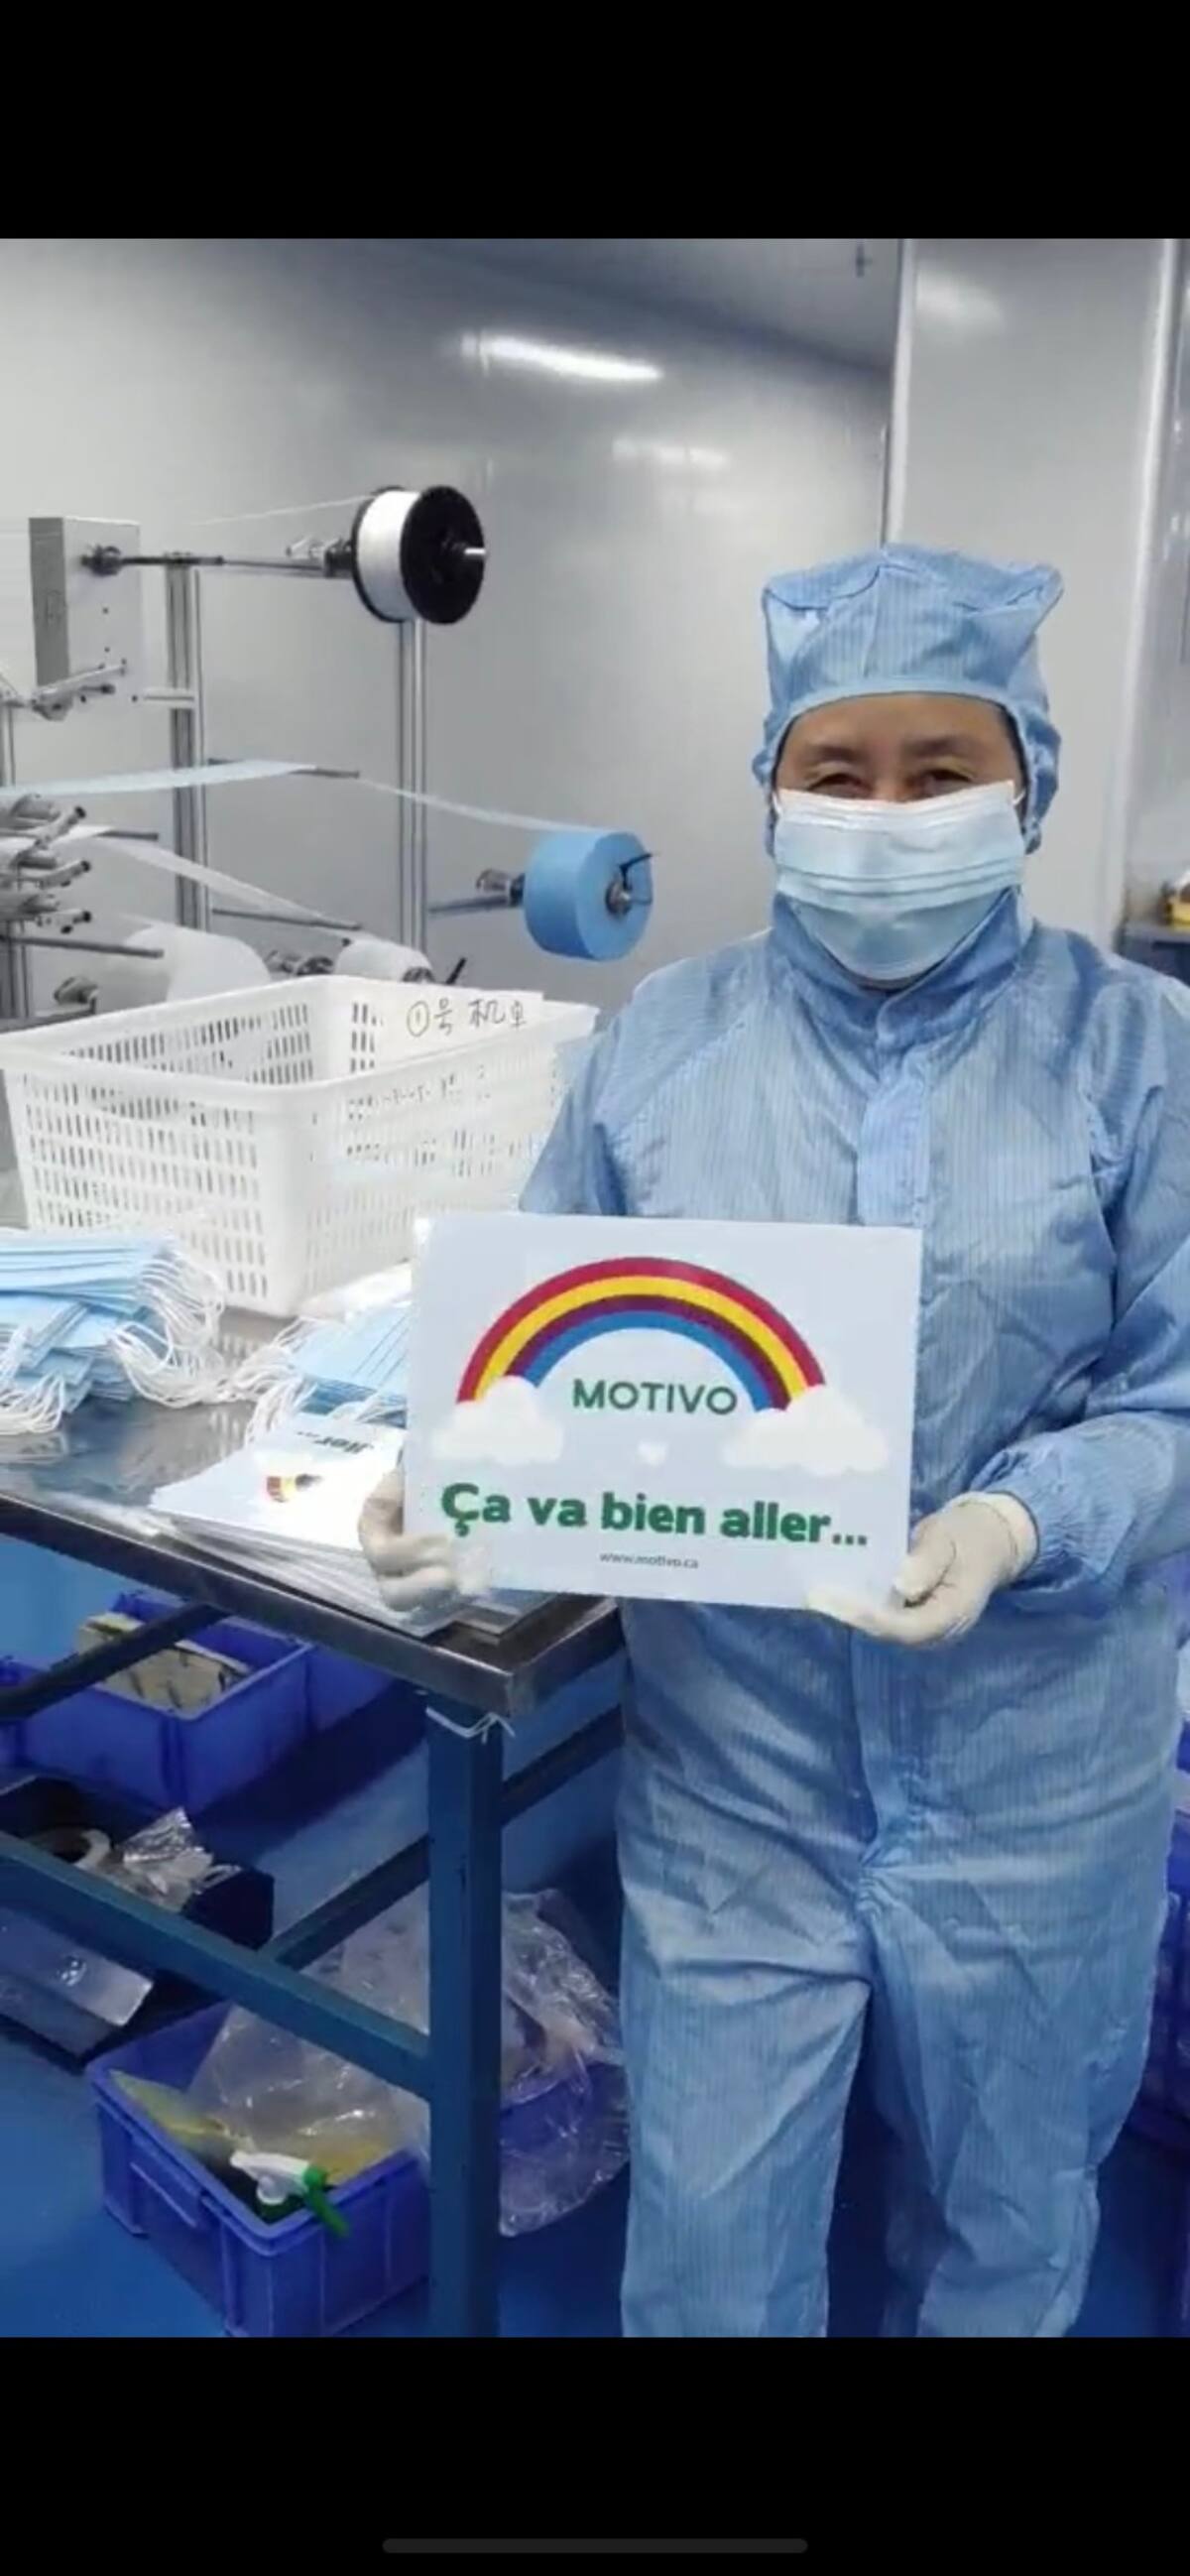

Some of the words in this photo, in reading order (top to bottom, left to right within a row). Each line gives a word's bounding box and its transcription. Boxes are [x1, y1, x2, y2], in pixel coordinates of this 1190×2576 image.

[572, 1379, 739, 1415] MOTIVO
[440, 1483, 512, 1537] Ça
[527, 1497, 588, 1529] va
[601, 1492, 705, 1534] bien
[719, 1500, 868, 1547] aller...
[599, 1551, 699, 1569] www.motivo.ca
